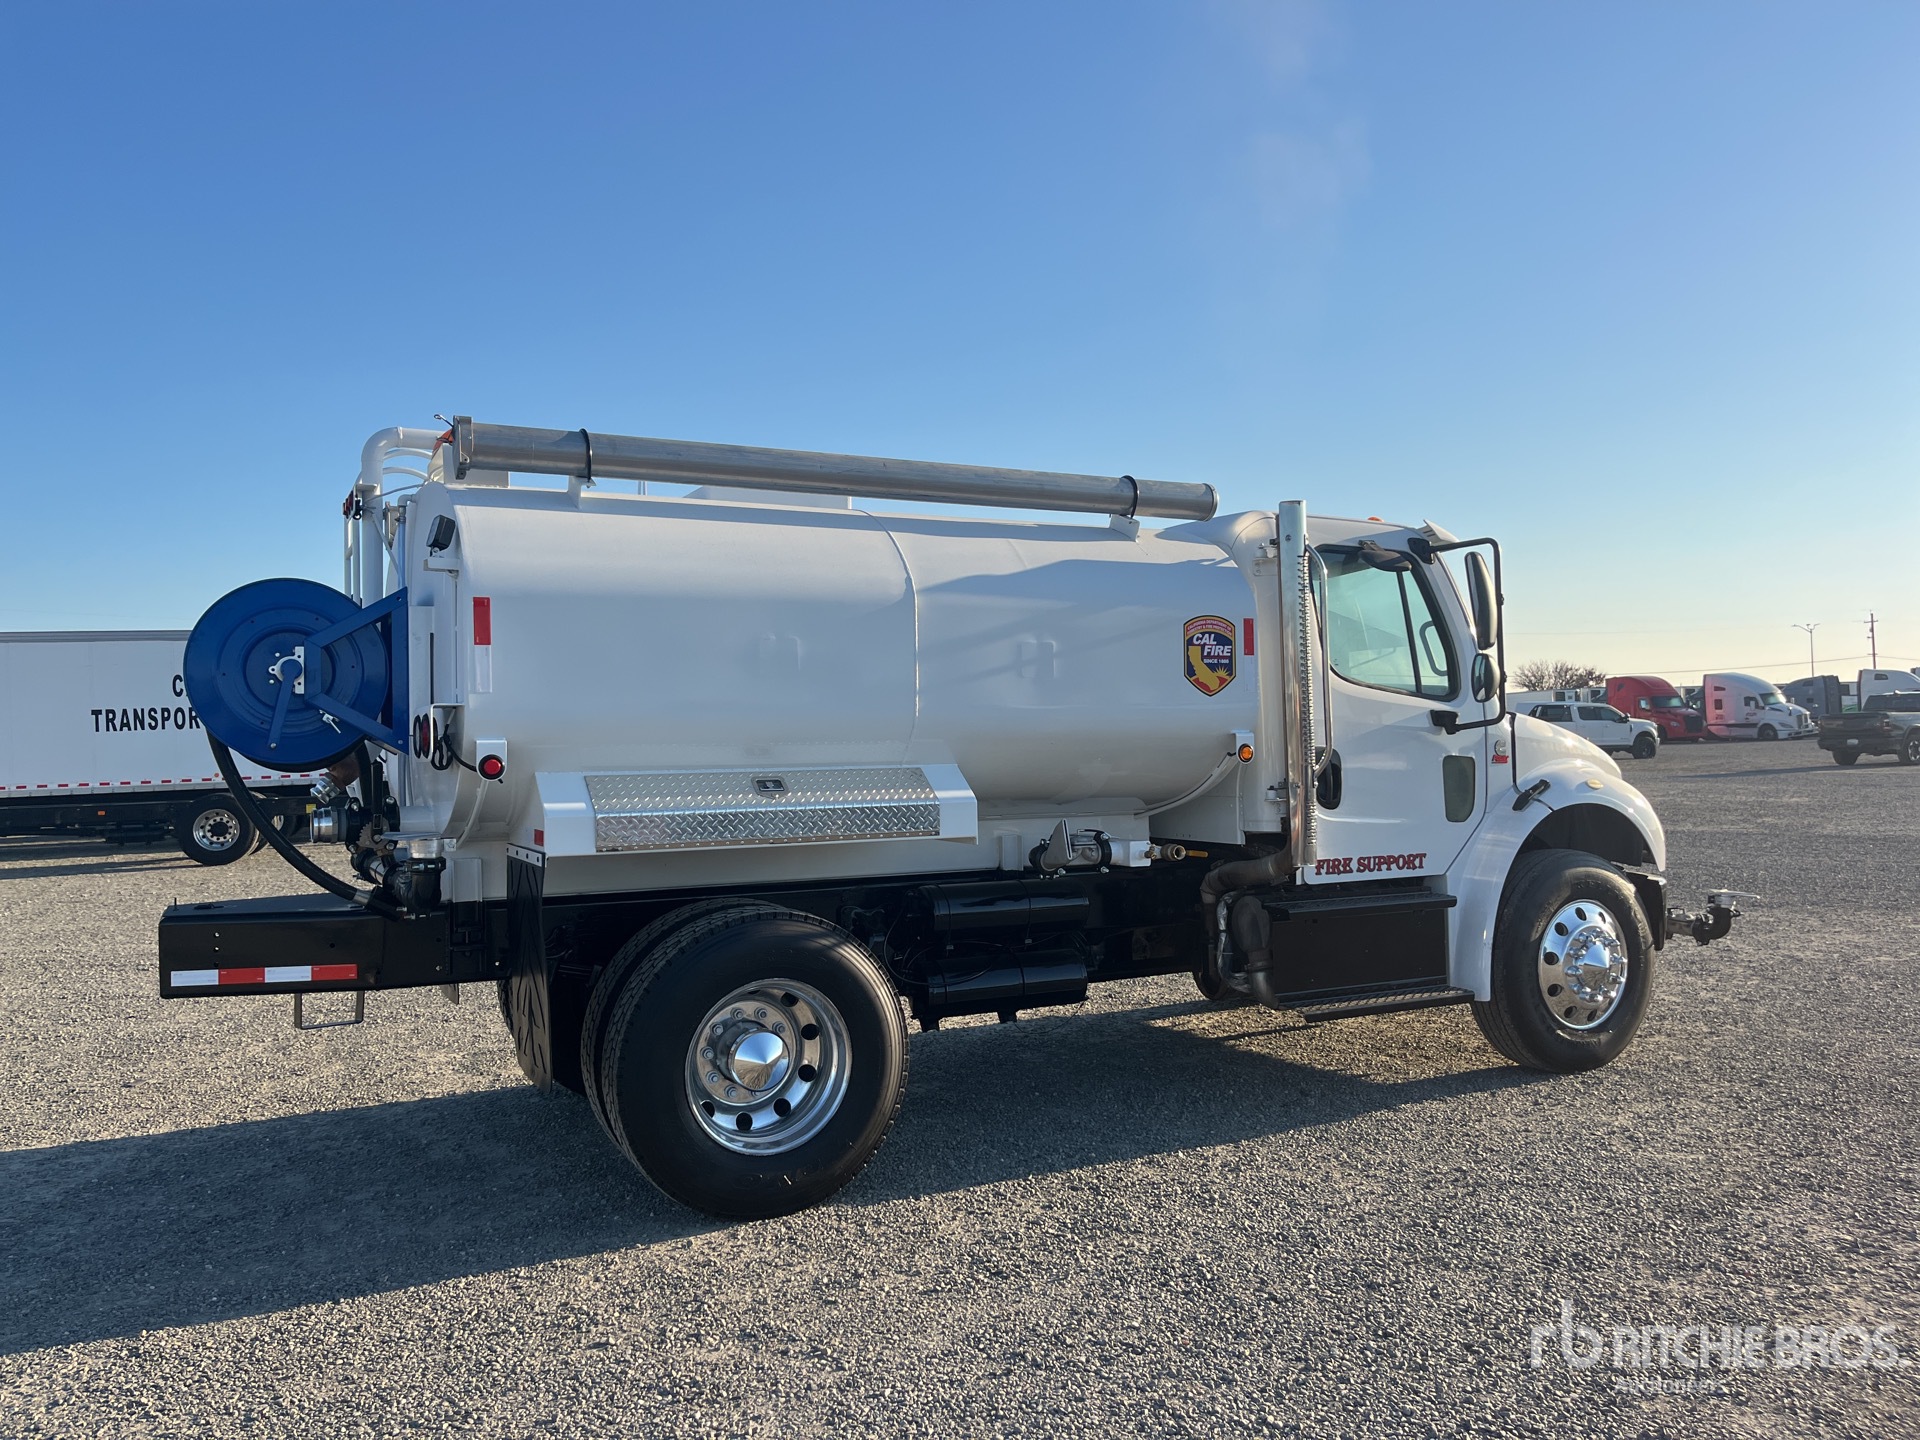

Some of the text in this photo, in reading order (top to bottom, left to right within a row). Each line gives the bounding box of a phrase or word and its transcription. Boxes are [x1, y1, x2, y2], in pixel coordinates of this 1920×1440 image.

[1193, 633, 1217, 645] CAL
[1203, 645, 1232, 656] FIRE
[91, 707, 200, 732] TRANSPOR
[1315, 853, 1427, 876] FIRE SUPPORT
